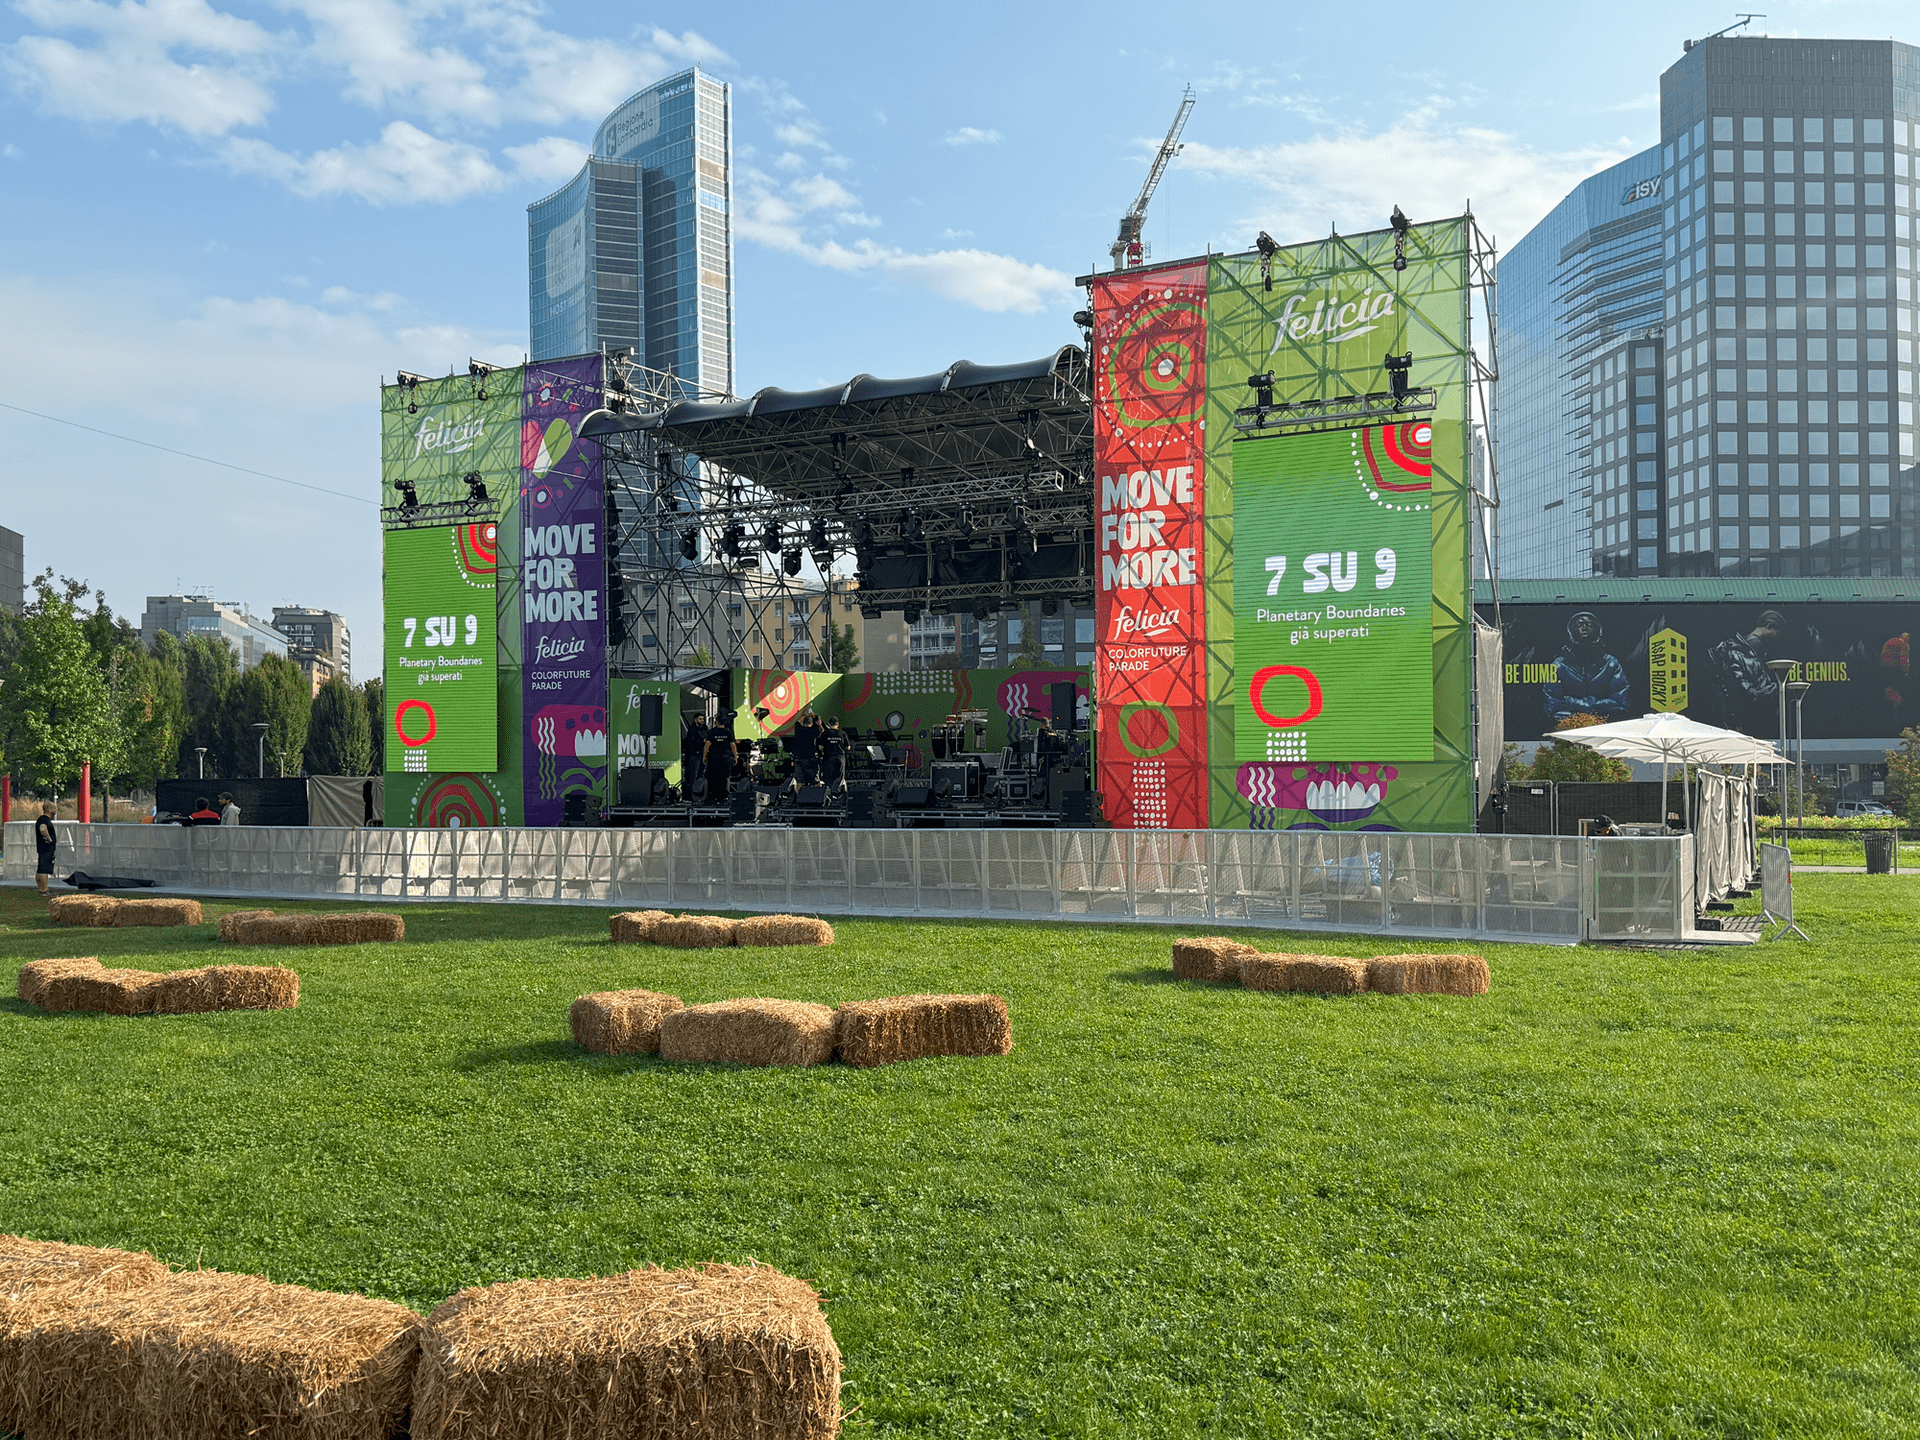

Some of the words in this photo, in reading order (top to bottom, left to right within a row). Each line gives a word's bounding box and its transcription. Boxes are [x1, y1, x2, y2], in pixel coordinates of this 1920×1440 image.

[617, 118, 654, 146] Lombardia
[618, 110, 645, 132] Regione
[1270, 288, 1398, 356] felicia
[413, 413, 486, 460] felicia
[1102, 466, 1194, 510] MOVE
[524, 522, 596, 558] MOVE
[1102, 511, 1166, 550] FOR
[524, 558, 575, 591] FOR
[1102, 548, 1196, 592] MORE
[1264, 555, 1288, 597] 7
[1302, 550, 1358, 594] SU
[1374, 547, 1398, 590] 9
[192, 585, 214, 600] ZTE
[524, 590, 598, 624] MORE
[1256, 606, 1322, 626] Planetary
[1326, 604, 1406, 621] Boundaries
[403, 617, 417, 648] 7
[424, 616, 456, 648] SU
[465, 613, 478, 646] 9
[1113, 605, 1180, 641] felicia
[1290, 627, 1310, 646] già
[1313, 624, 1370, 643] superati
[399, 655, 436, 670] Planetary
[438, 653, 483, 667] Boundaries
[535, 635, 586, 664] felicia
[1108, 645, 1188, 660] COLORFUTURE
[418, 670, 431, 685] già
[432, 669, 463, 683] superati
[531, 669, 591, 681] COLORFUTURE
[1108, 660, 1150, 672] PARADE
[1505, 664, 1520, 683] BE
[1523, 664, 1561, 683] DUMB.
[1789, 662, 1803, 681] BE
[1805, 661, 1850, 681] GENIUS.
[531, 681, 563, 690] PARADE
[1651, 670, 1667, 707] ROCKY
